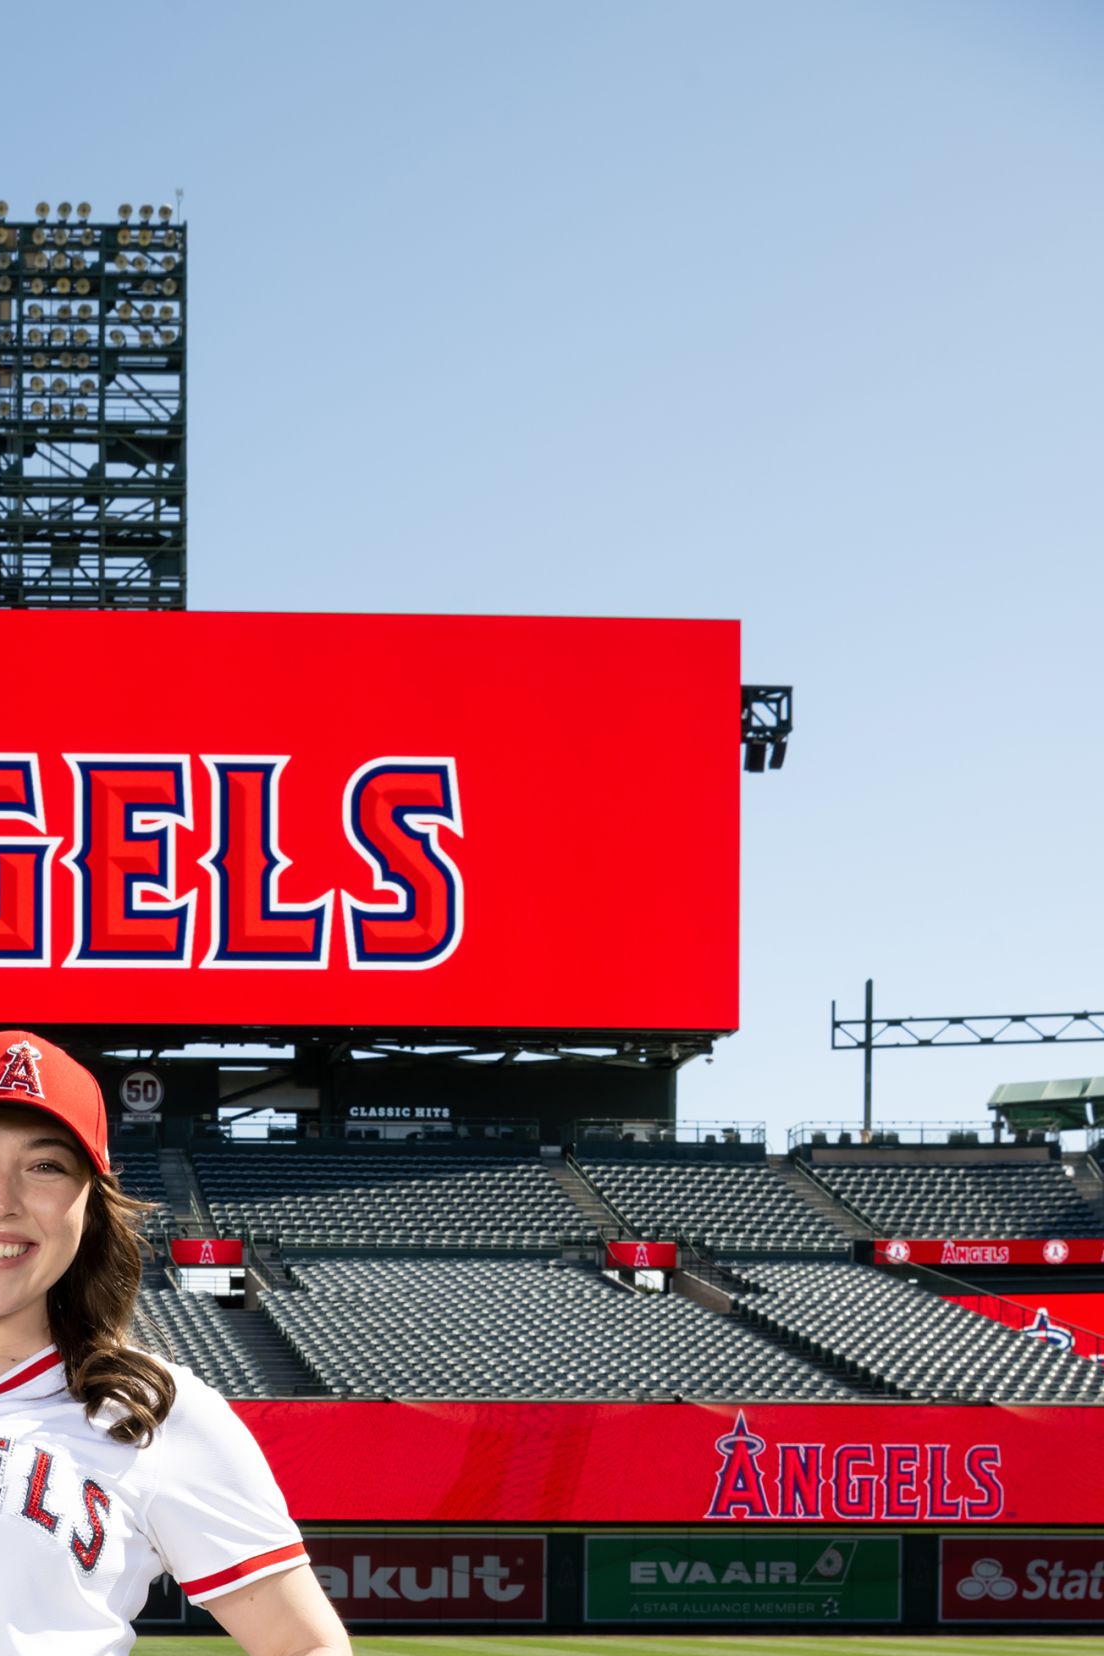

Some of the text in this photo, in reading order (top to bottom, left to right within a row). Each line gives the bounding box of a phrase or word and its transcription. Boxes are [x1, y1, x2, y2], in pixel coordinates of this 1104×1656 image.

[127, 1079, 157, 1103] 50
[349, 1106, 451, 1118] CLASSIC HITS
[199, 1240, 215, 1264] A
[633, 1242, 650, 1267] A
[941, 1240, 1009, 1263] ANGELS
[704, 1408, 1004, 1520] ANGELS
[312, 1555, 526, 1602] akult
[630, 1561, 797, 1584] EVA AIR
[1022, 1558, 1104, 1601] Stat
[630, 1602, 816, 1614] A STAR ALLIANCE MEMBER
